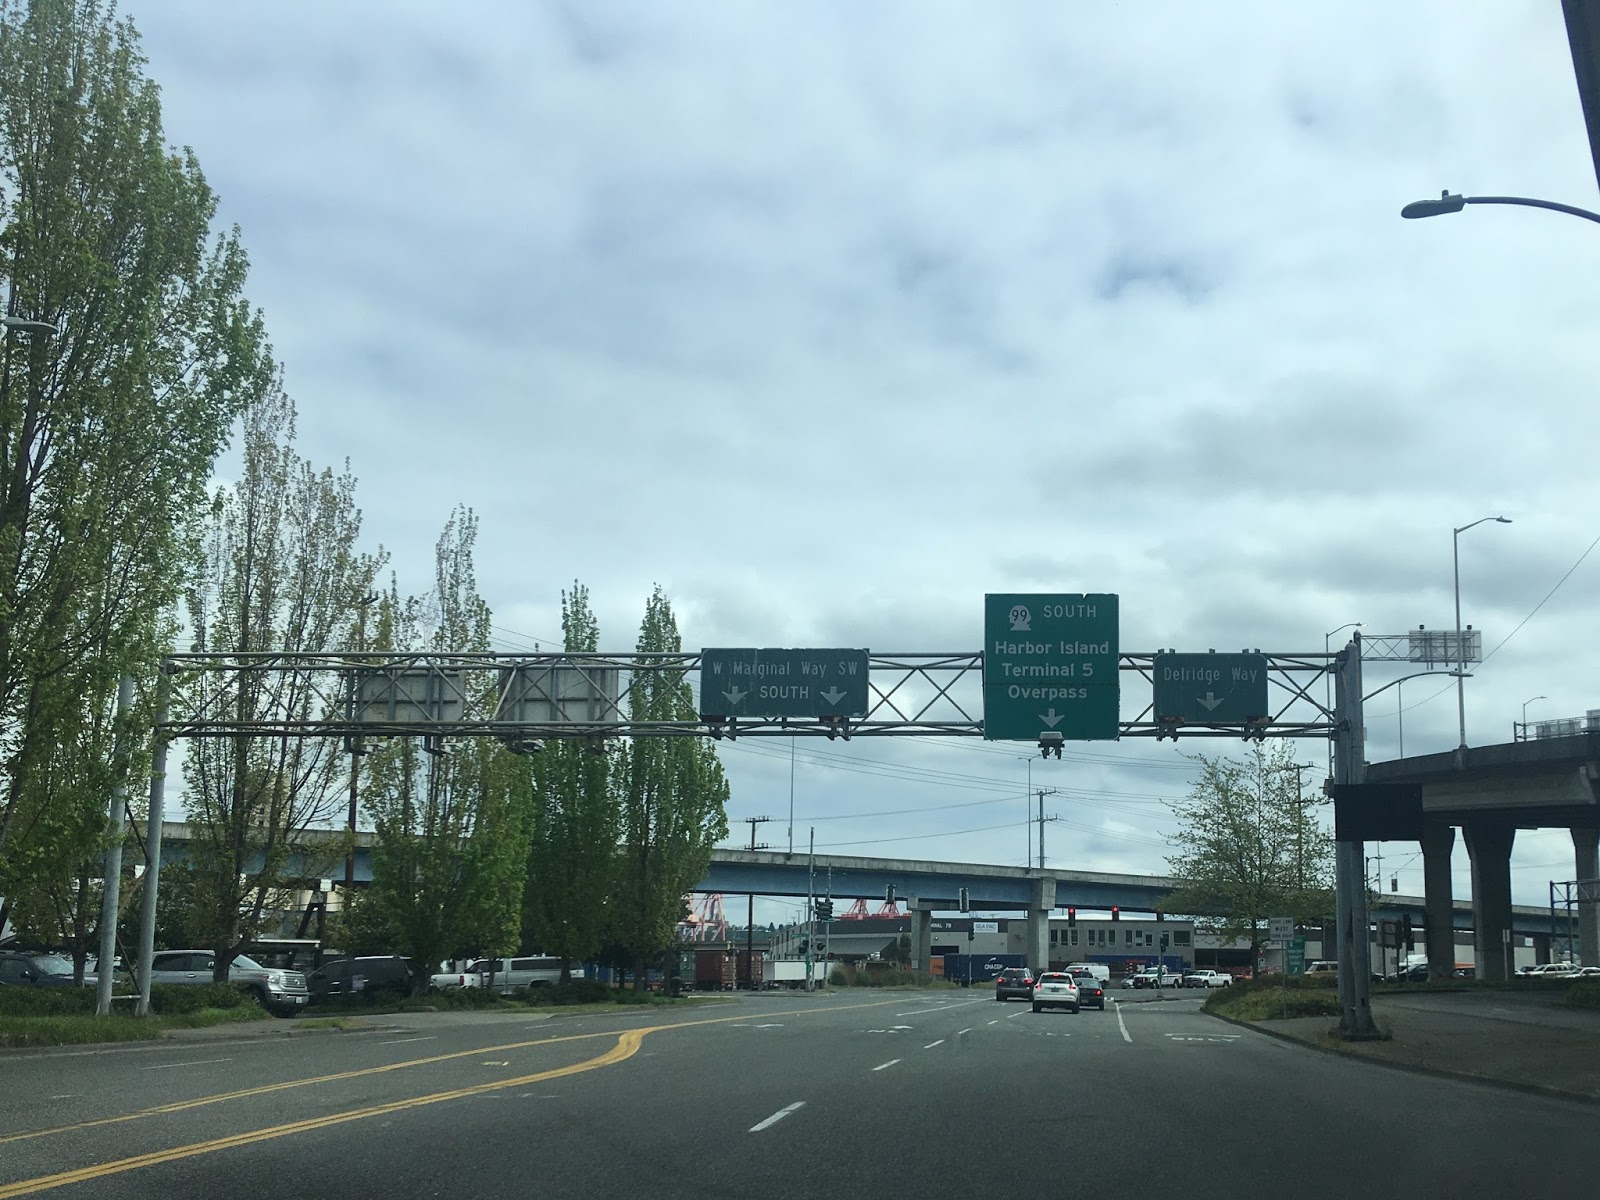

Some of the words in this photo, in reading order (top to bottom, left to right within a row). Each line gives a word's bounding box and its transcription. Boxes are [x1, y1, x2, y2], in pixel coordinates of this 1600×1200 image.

[1011, 609, 1028, 622] 99
[1043, 604, 1097, 618] SOUTH
[994, 640, 1052, 655] Harbor
[1060, 640, 1109, 655] Island
[712, 661, 723, 676] W
[733, 661, 790, 680] Marginal
[801, 661, 827, 679] Way
[838, 661, 858, 676] SW
[1001, 662, 1075, 677] Terminal
[1082, 662, 1094, 677] 5
[1163, 666, 1221, 685] Delridge
[1231, 667, 1258, 683] Way
[759, 685, 809, 699] SOUTH
[1007, 684, 1088, 702] Overpass
